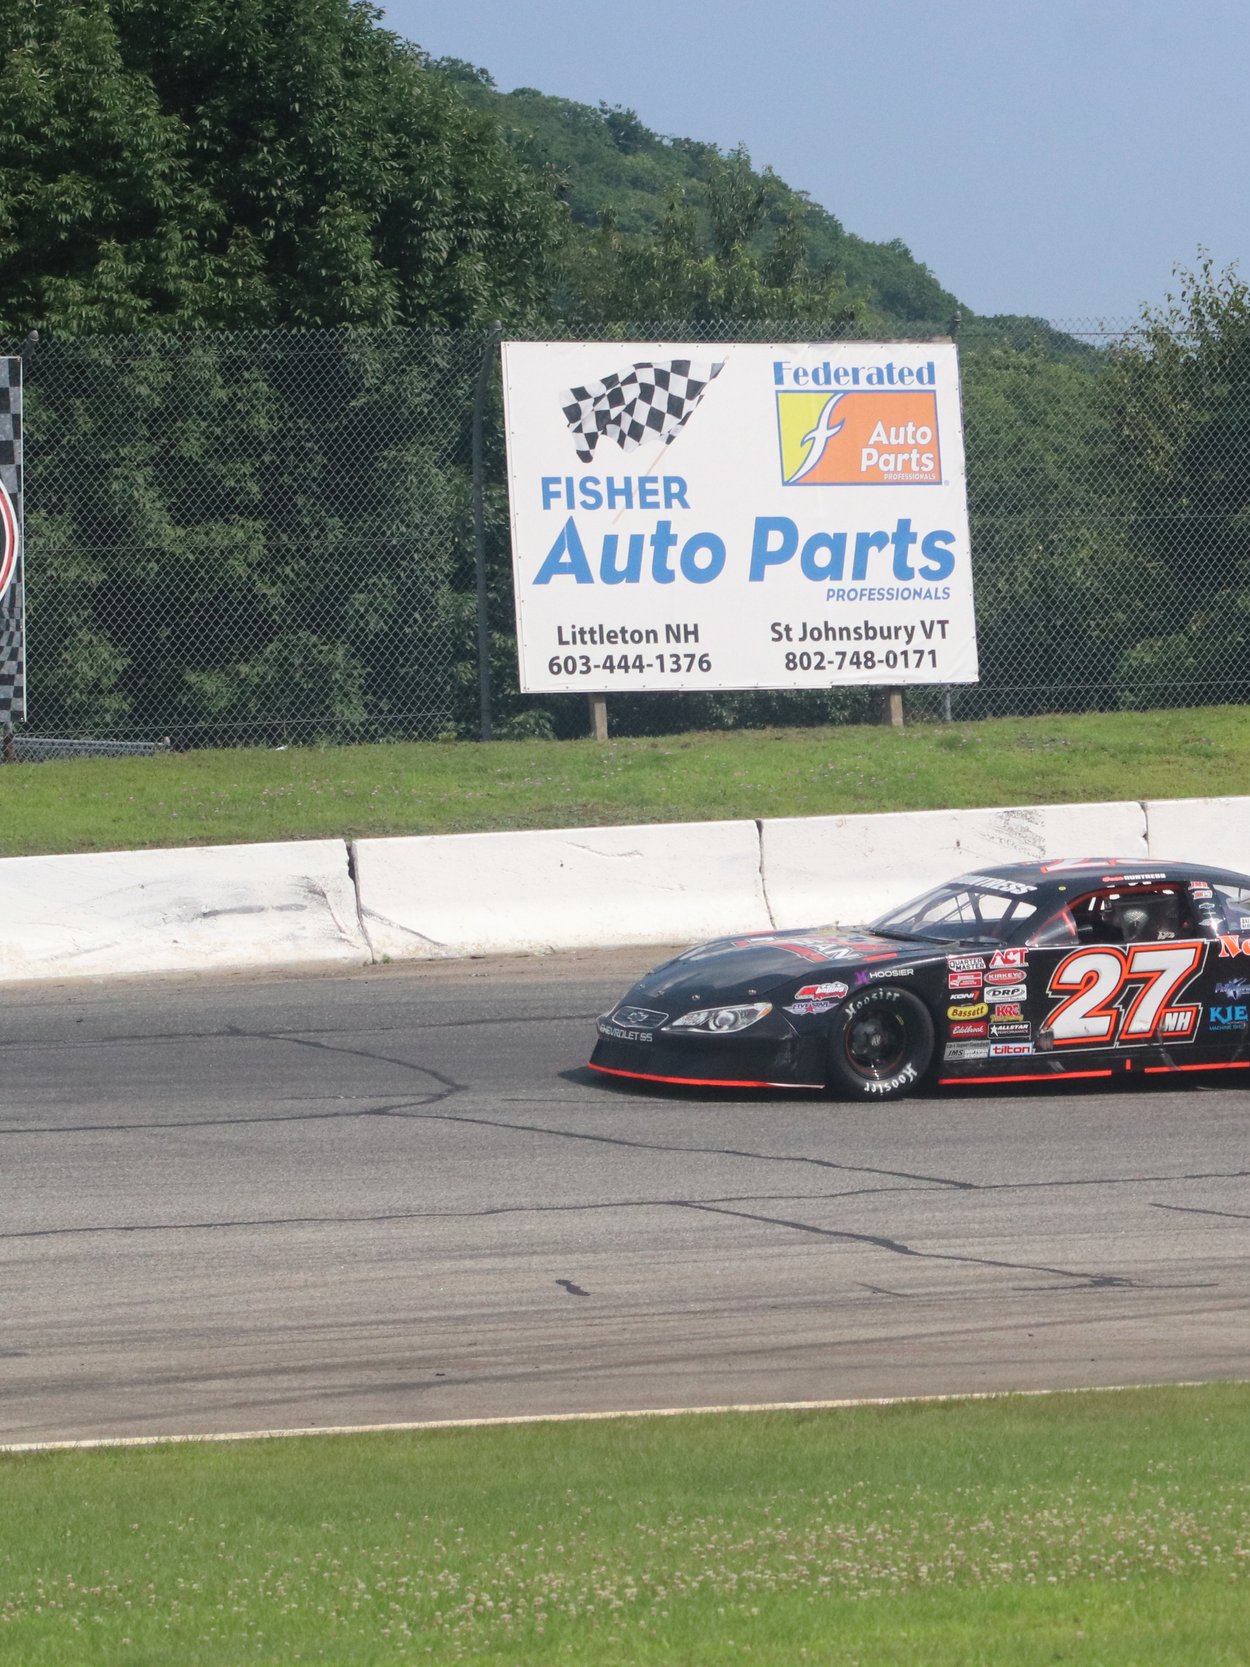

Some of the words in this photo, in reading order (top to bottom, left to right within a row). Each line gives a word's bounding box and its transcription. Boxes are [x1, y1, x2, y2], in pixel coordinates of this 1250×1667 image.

[773, 362, 936, 386] Federated
[868, 421, 932, 445] Auto
[860, 448, 935, 472] Parts
[541, 476, 691, 510] FISHER
[533, 516, 727, 585] Auto
[748, 516, 956, 582] Parts
[826, 587, 951, 602] PROFESSIONALS
[557, 624, 658, 646] Littleton
[665, 624, 700, 645] NH
[770, 622, 793, 642] St
[798, 620, 915, 645] Johnsbury
[920, 620, 949, 639] VT
[548, 653, 712, 675] 603-444-1376
[785, 649, 938, 671] 802-748-0171
[990, 948, 1028, 966] ACT
[869, 968, 914, 978] HOOSIER
[992, 988, 1020, 996] DRP
[1042, 943, 1203, 1043] 27
[952, 1006, 984, 1017] Bassett
[996, 1004, 1020, 1017] KRC
[1164, 1010, 1192, 1032] NH
[600, 1024, 639, 1040] CHEVROLET
[640, 1032, 653, 1042] SS
[993, 1045, 1030, 1055] tilton
